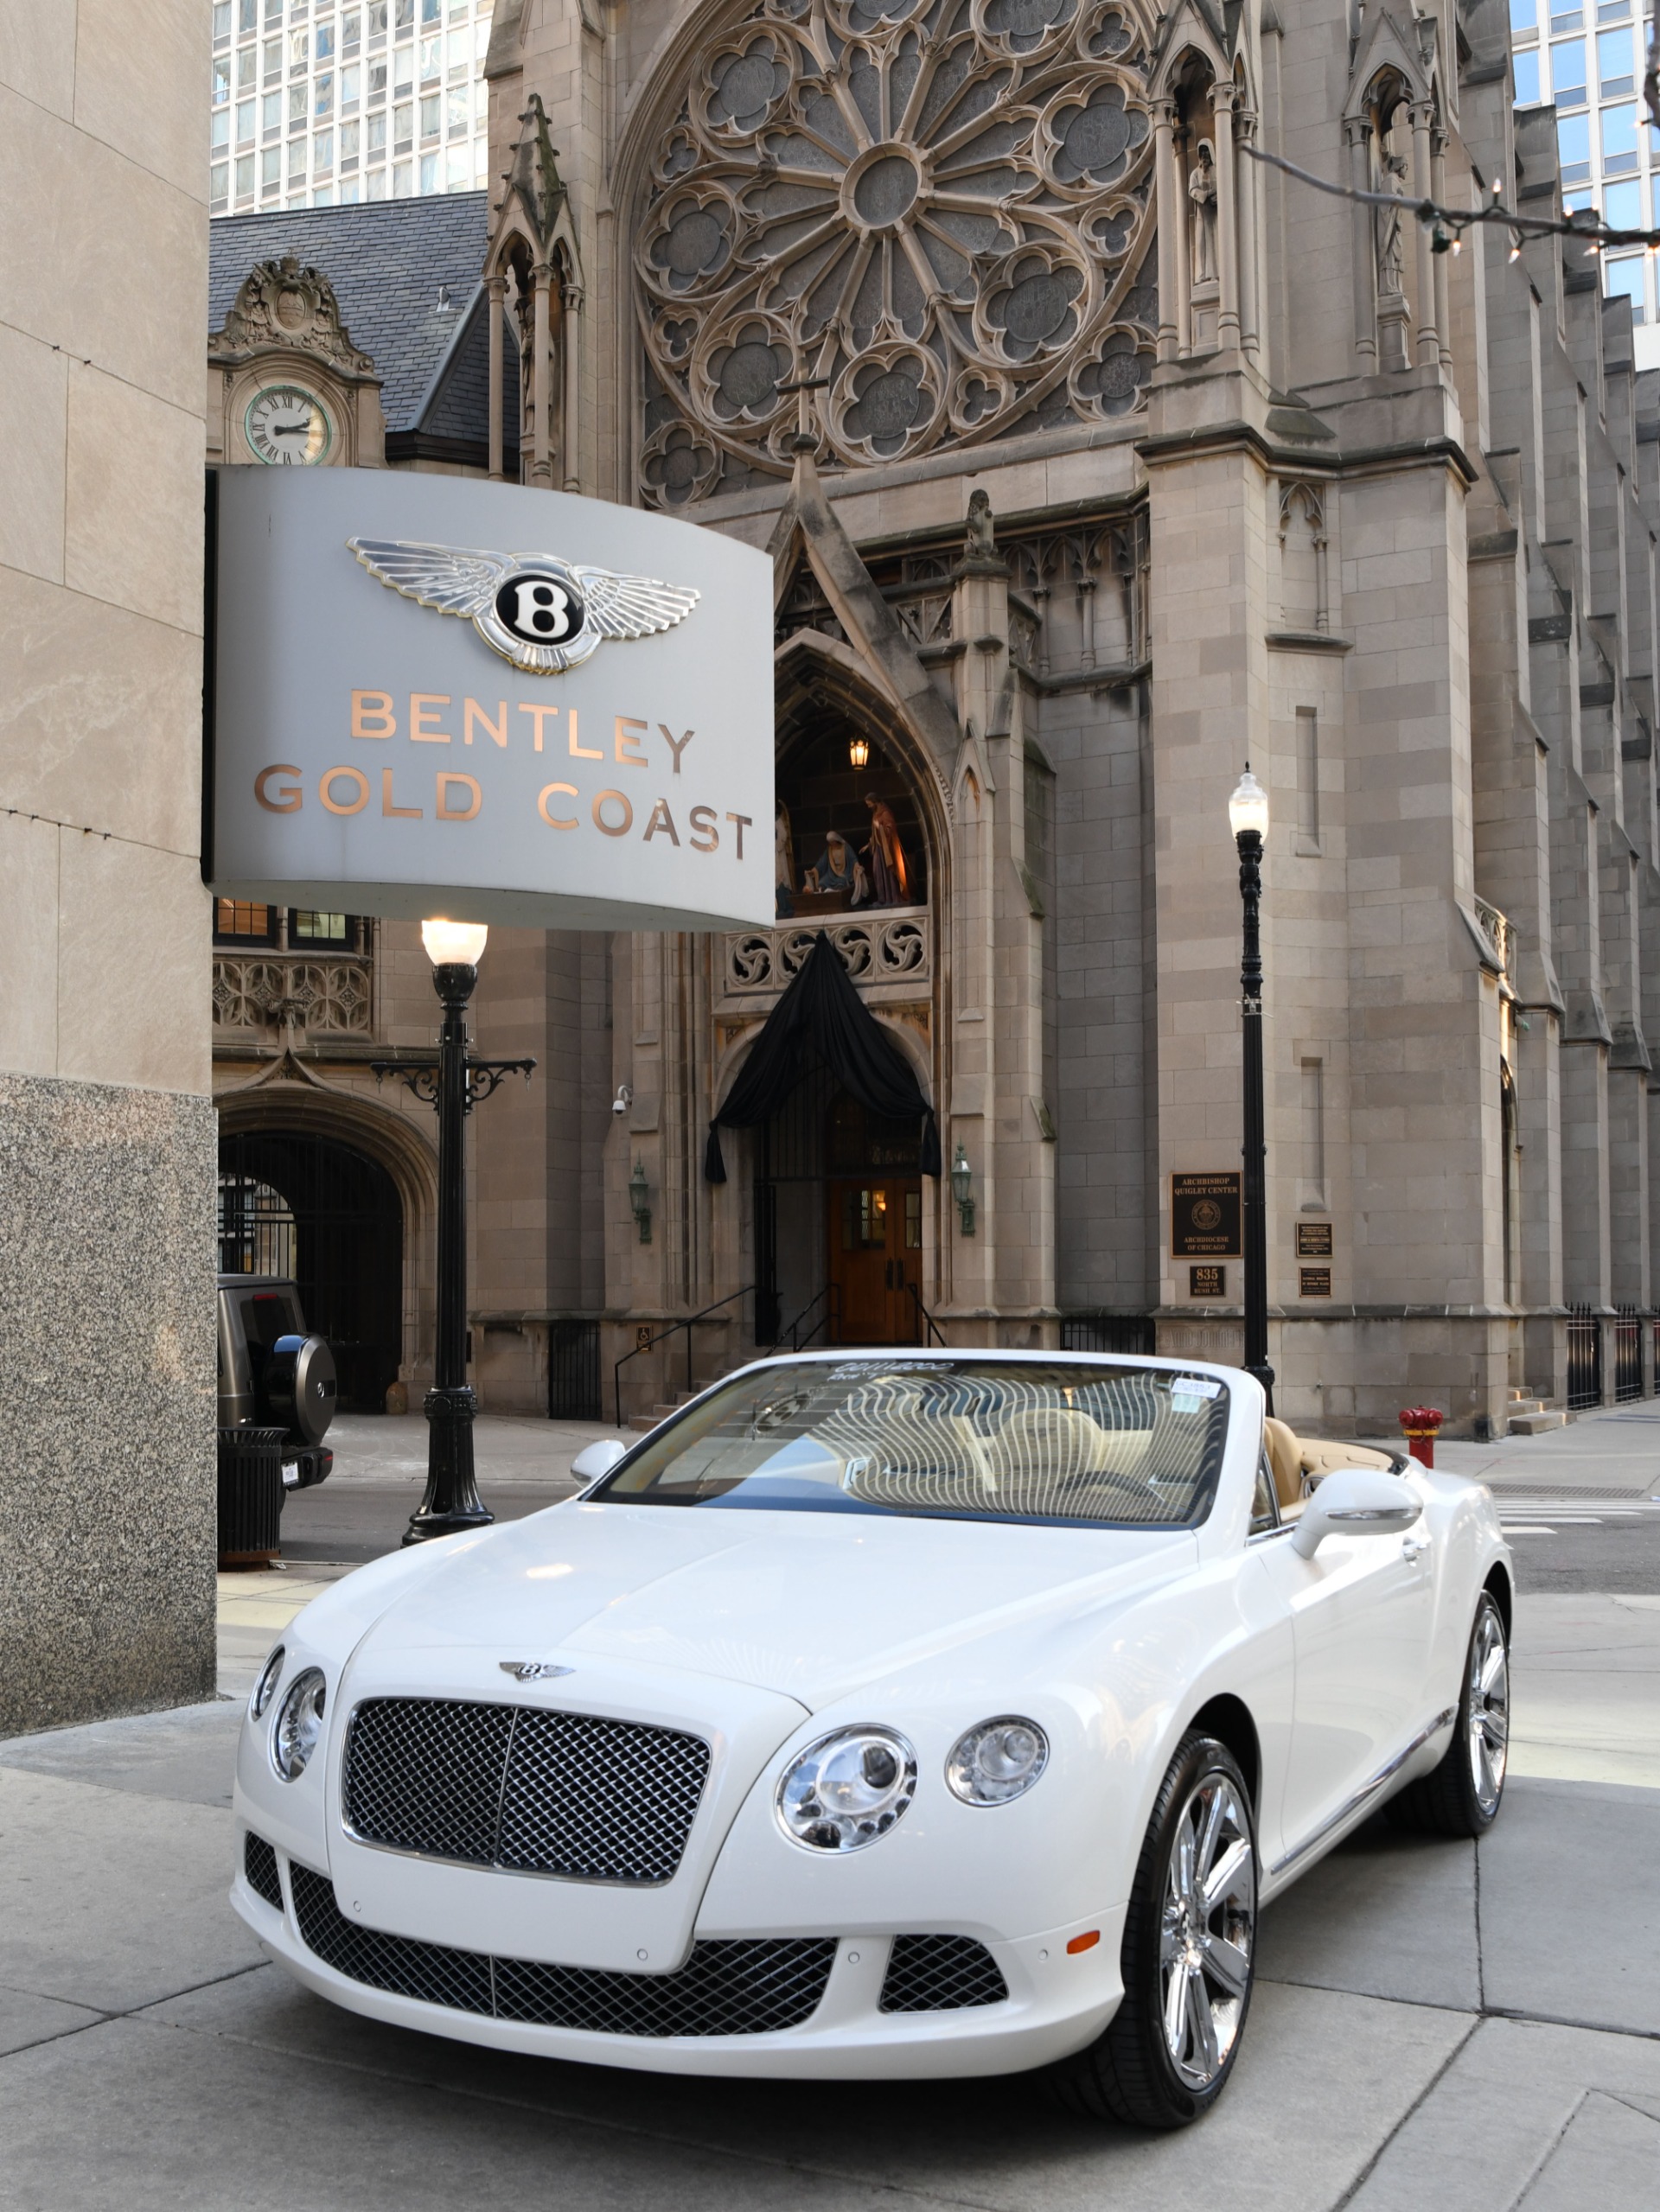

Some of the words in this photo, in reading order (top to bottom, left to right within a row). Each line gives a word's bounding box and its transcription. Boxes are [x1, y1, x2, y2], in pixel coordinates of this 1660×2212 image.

[514, 580, 571, 638] B
[351, 688, 696, 774] BENTLEY
[253, 763, 483, 822] GOLD
[537, 781, 753, 861] COAST
[1196, 1268, 1218, 1280] 835
